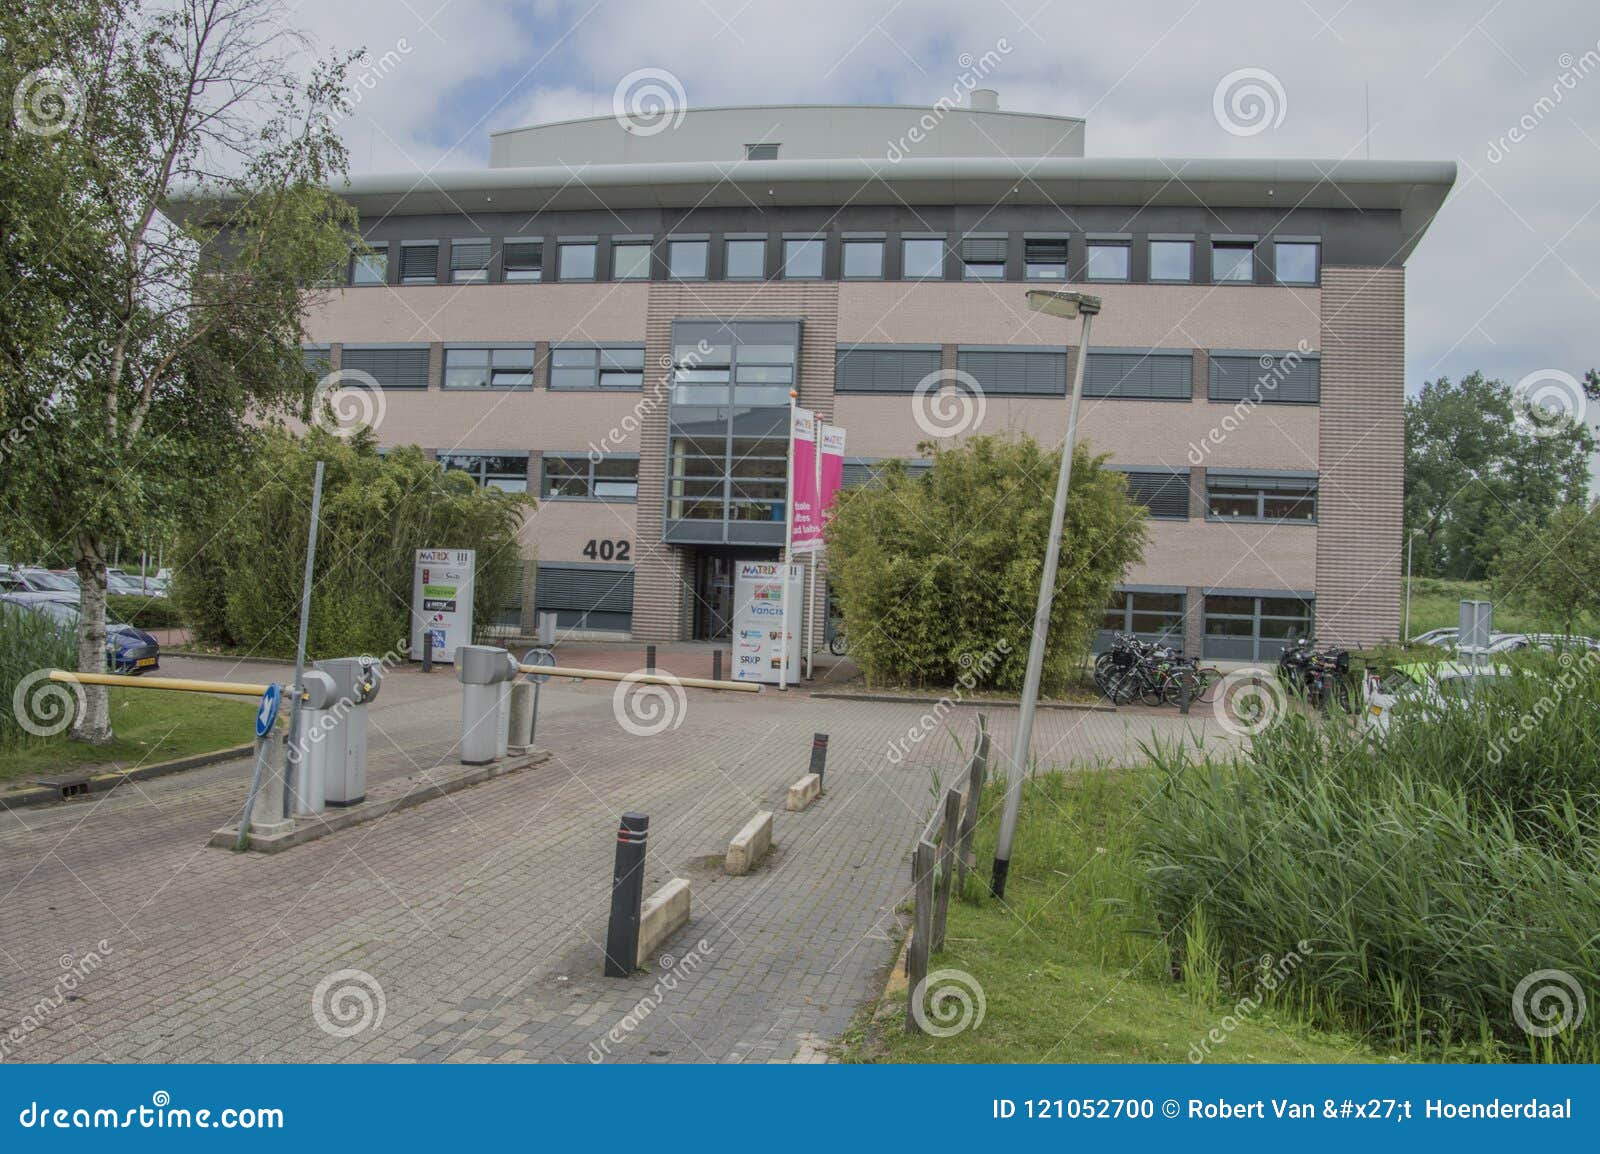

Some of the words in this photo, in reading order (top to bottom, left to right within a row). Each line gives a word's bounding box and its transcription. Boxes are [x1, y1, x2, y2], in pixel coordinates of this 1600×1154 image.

[583, 539, 630, 561] 402
[742, 565, 777, 575] MATRIX
[751, 605, 784, 616] Vancis
